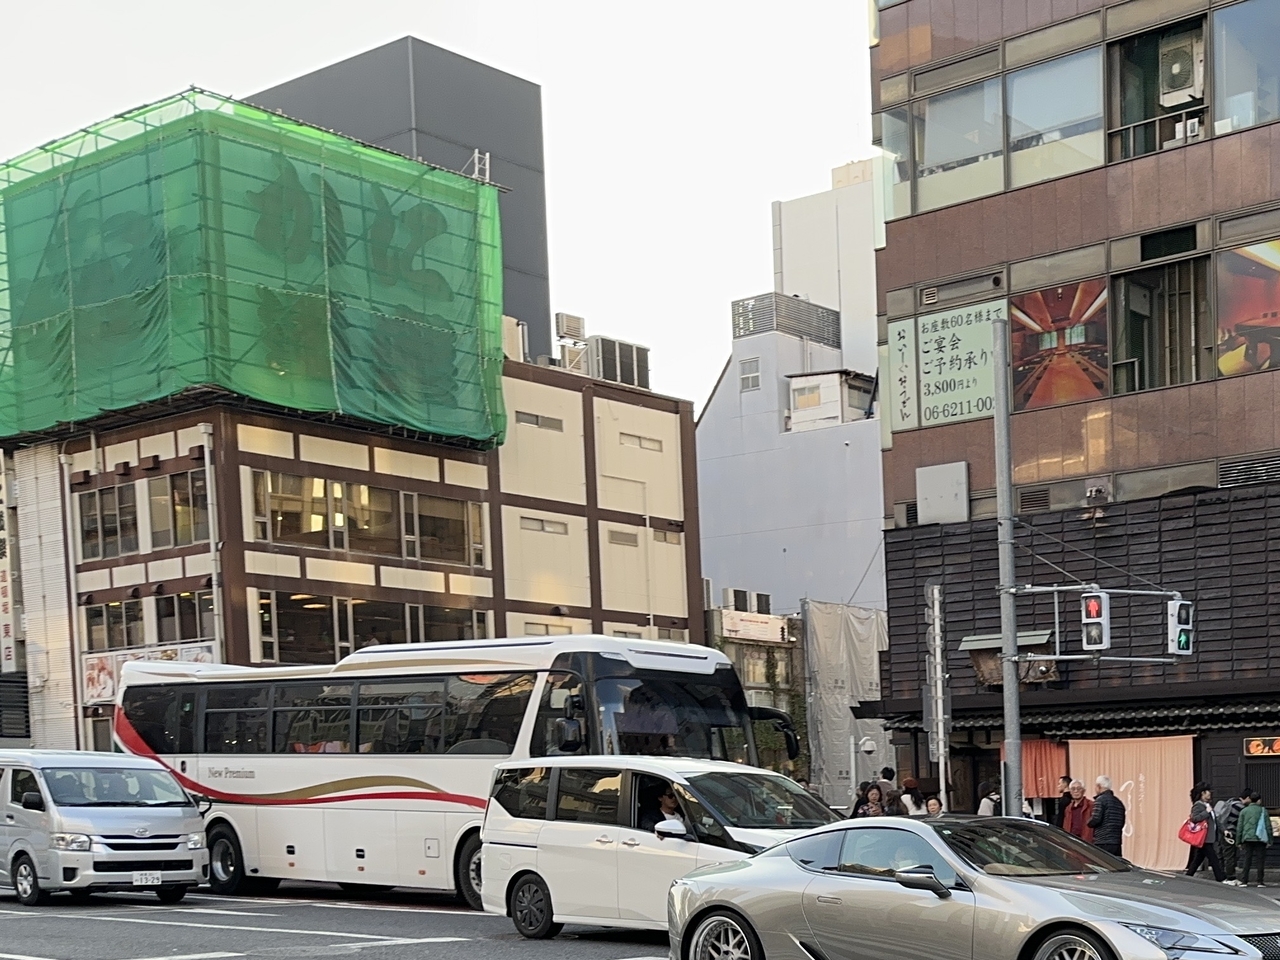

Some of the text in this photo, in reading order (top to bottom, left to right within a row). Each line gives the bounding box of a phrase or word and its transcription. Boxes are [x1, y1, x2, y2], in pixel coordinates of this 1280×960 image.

[922, 332, 962, 355] ご宴会
[922, 348, 994, 375] ご予約承り
[923, 377, 978, 397] 3,800円より
[924, 395, 995, 421] 06-6211-00
[208, 767, 255, 779] New Premium
